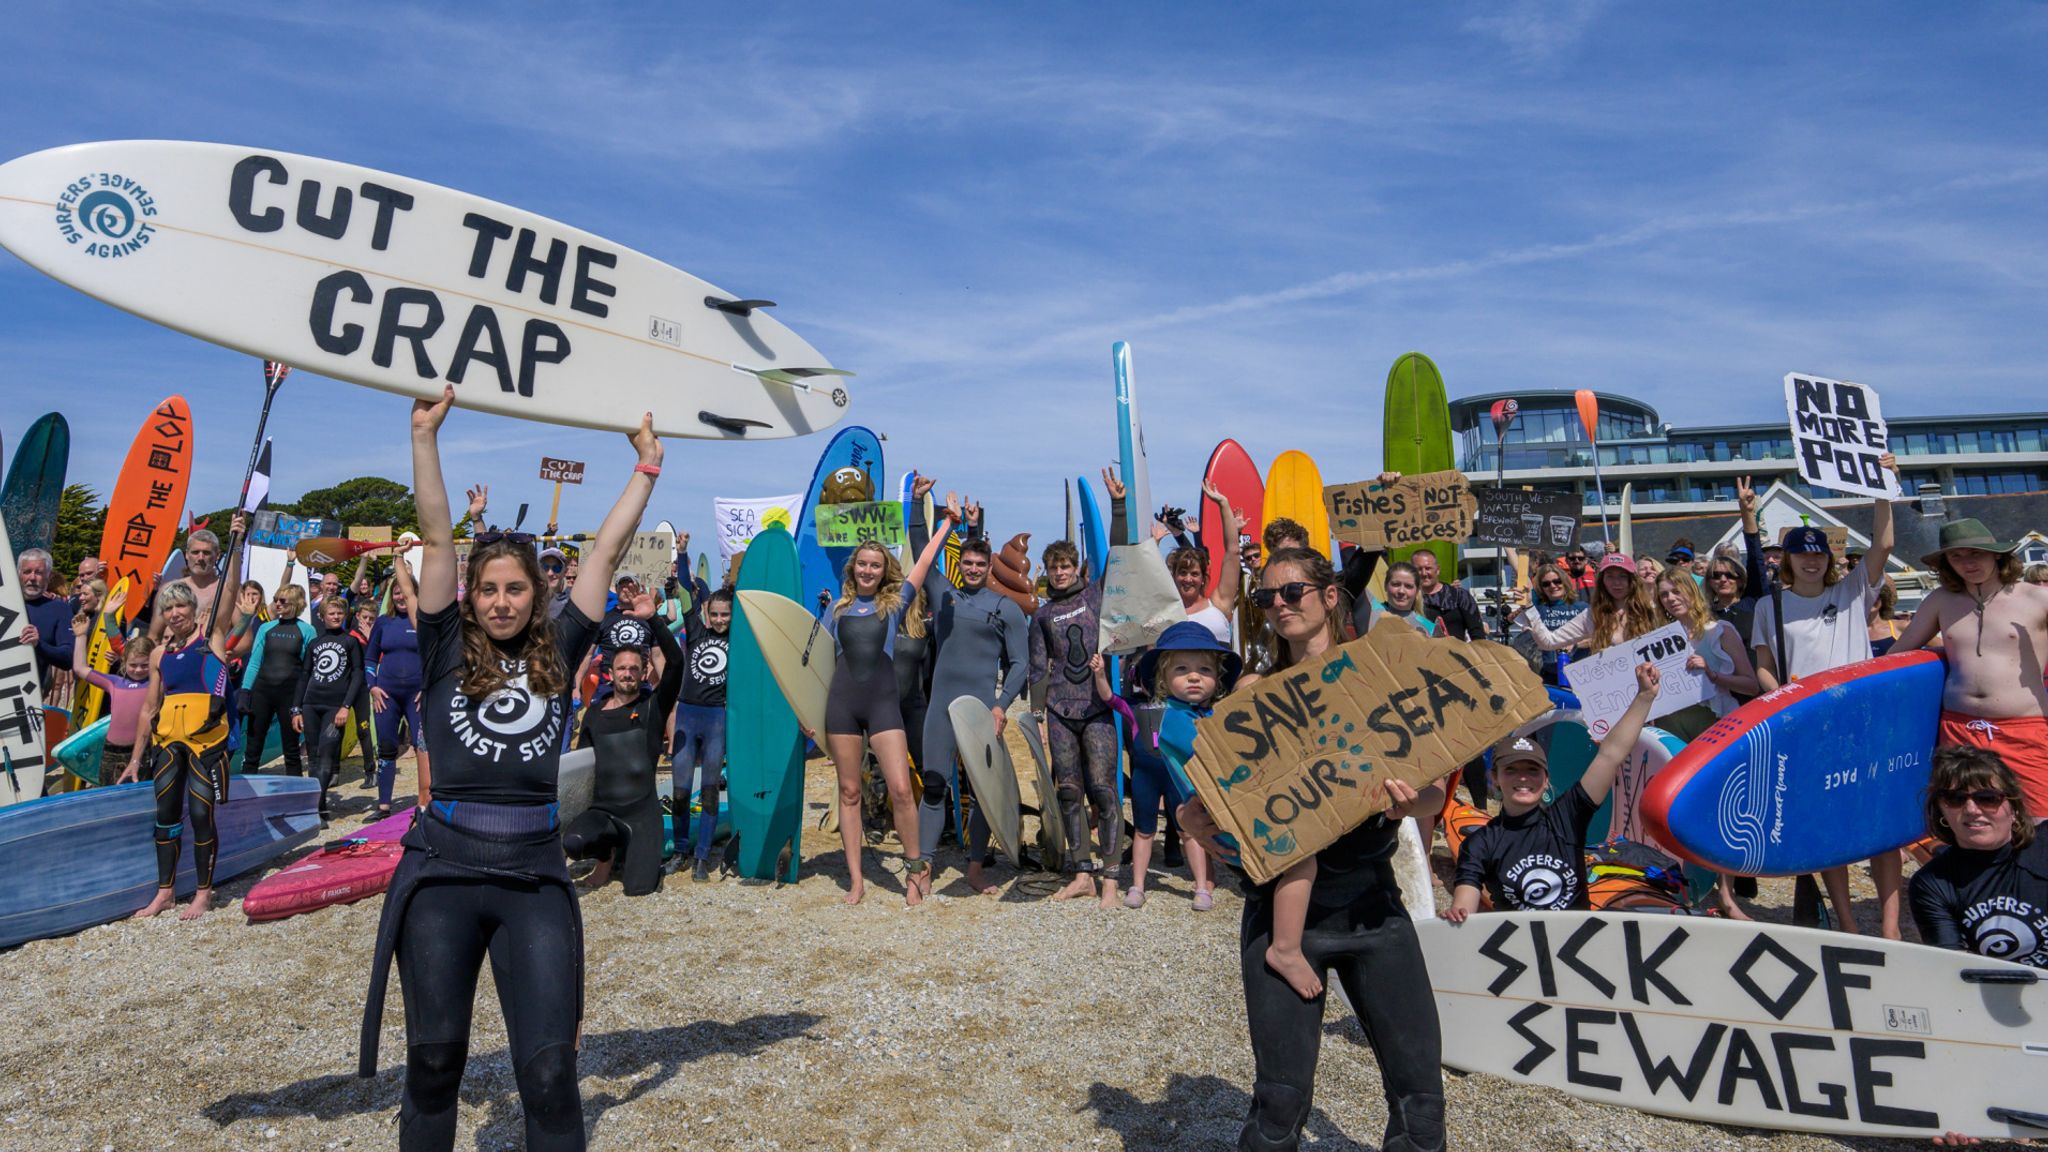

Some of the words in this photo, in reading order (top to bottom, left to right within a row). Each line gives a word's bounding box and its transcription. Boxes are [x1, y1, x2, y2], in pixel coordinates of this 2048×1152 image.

[99, 173, 157, 216] SEWAGE
[85, 223, 156, 258] AGAINST
[463, 212, 617, 319] THE
[309, 270, 571, 398] CRAP
[1794, 378, 1872, 420] NO
[148, 403, 187, 473] PLOP
[1796, 410, 1886, 449] MORE
[542, 468, 561, 479] THE
[562, 471, 583, 480] CRAP
[548, 461, 576, 472] CUT
[1800, 437, 1888, 490] POO
[147, 480, 173, 509] THE
[1332, 489, 1406, 515] Fishes
[1424, 485, 1462, 504] NOT
[1484, 503, 1531, 513] WATER
[1486, 491, 1522, 502] SOUTH
[1529, 493, 1556, 503] WEST
[277, 516, 322, 535] VOTE
[730, 508, 754, 521] SEA
[839, 507, 886, 524] SWW
[649, 536, 664, 550] TO
[726, 524, 753, 537] SICK
[827, 531, 848, 543] ARE
[114, 512, 156, 586] STOP
[1054, 606, 1086, 622] CRESSI
[1636, 634, 1686, 662] TURD
[450, 680, 507, 762] GAINST
[519, 693, 561, 762] SEWAG
[1224, 672, 1328, 760] SAVE
[1888, 751, 1919, 773] TOUR
[1264, 759, 1357, 824] OUR
[1824, 767, 1857, 790] PACE
[1506, 855, 1563, 882] SURFERS
[1478, 916, 1694, 1006] SICK
[1729, 932, 1885, 1031] OF
[1506, 1002, 1940, 1129] SEWAGE
